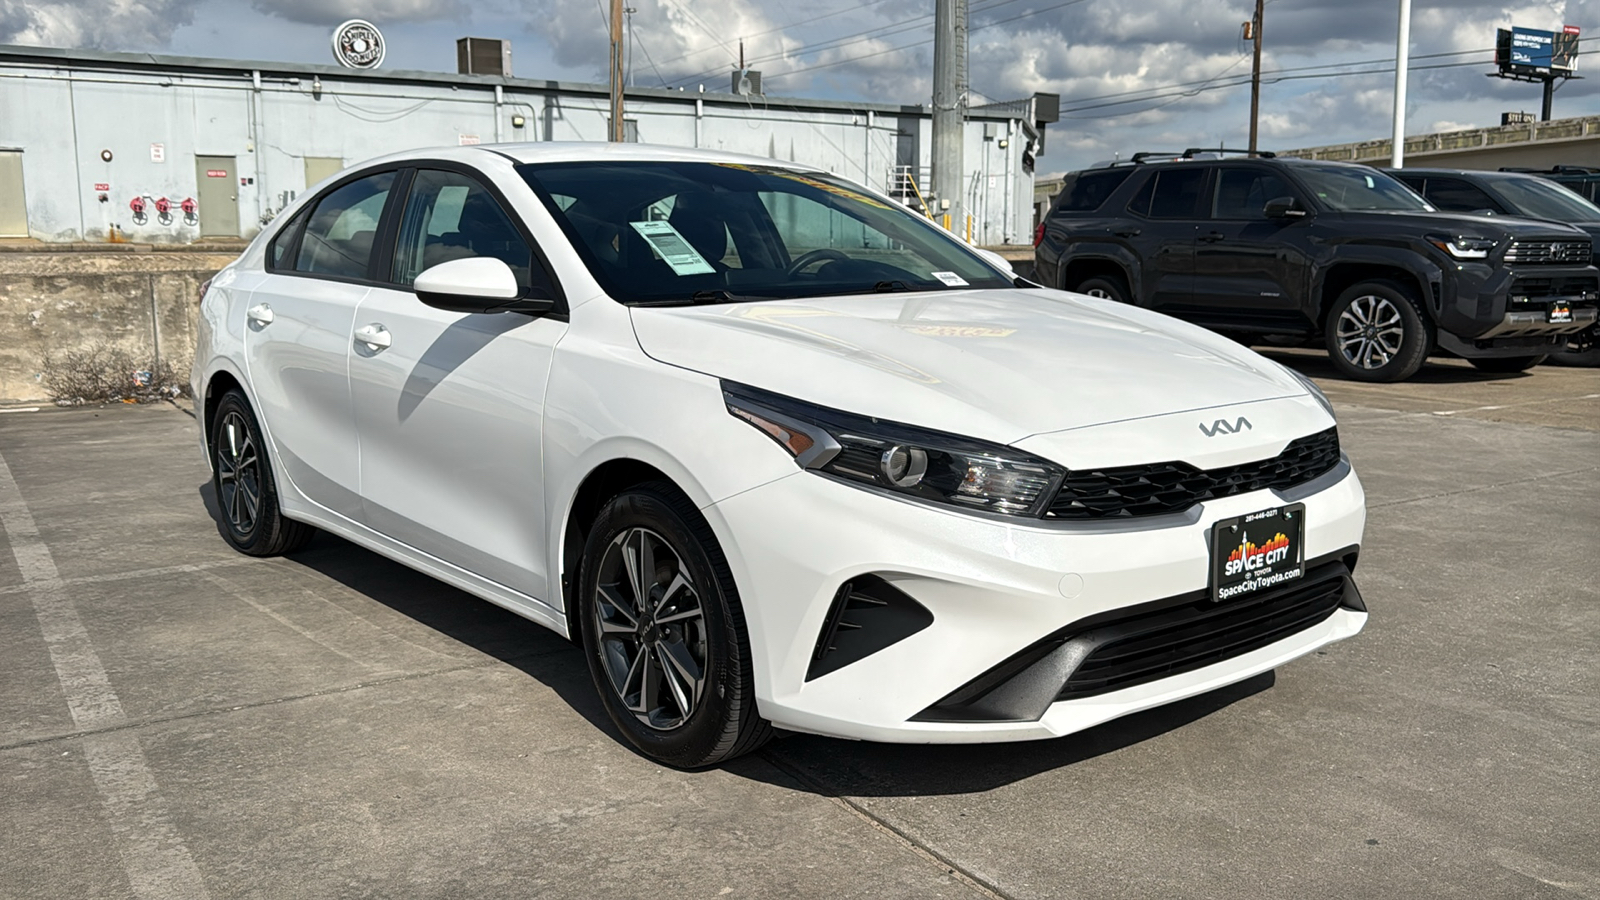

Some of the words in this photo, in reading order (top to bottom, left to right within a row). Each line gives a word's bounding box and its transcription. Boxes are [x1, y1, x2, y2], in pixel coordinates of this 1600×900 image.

[1198, 416, 1253, 437] KIA
[1224, 541, 1264, 576] SPACE
[1265, 544, 1289, 565] CITY
[1254, 566, 1272, 577] TOYOTA
[1218, 568, 1300, 599] SpaceCityToyota.com
